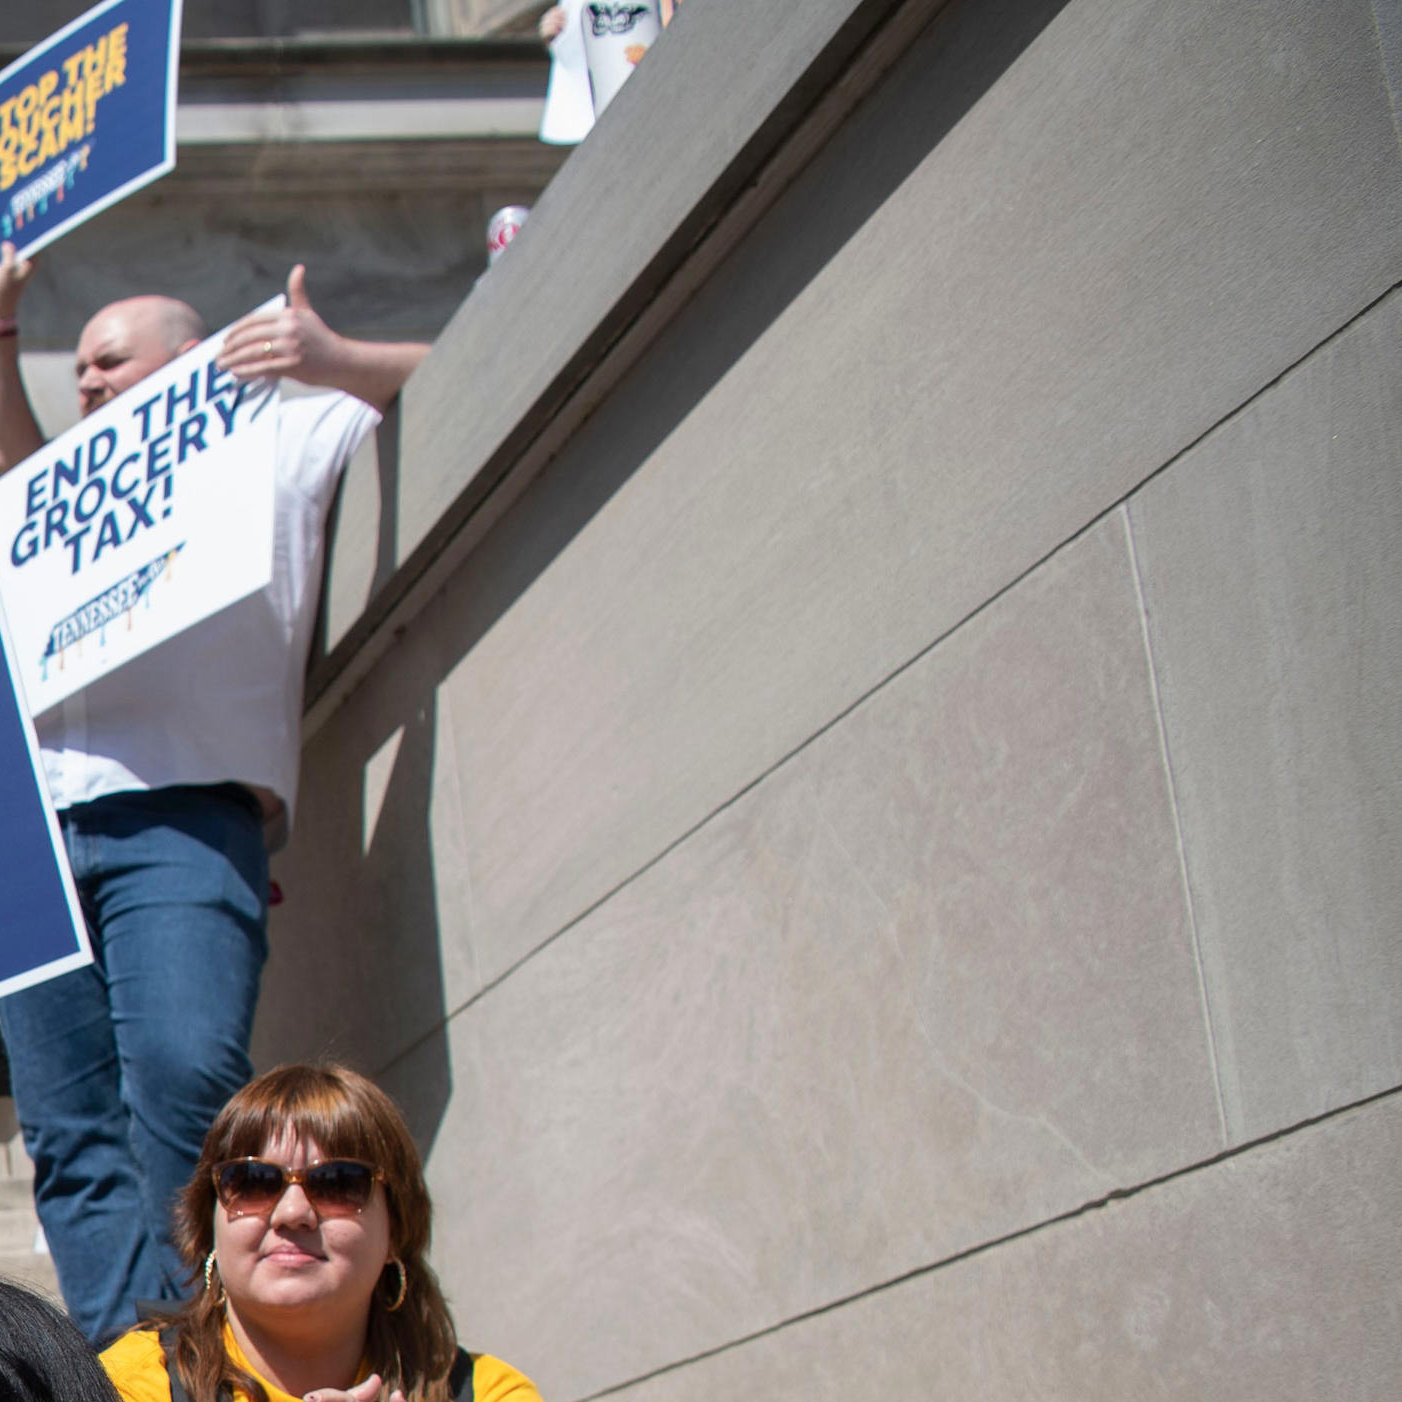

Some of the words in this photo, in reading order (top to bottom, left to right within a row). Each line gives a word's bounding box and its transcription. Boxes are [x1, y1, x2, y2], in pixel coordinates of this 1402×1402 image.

[63, 22, 129, 85] THE
[0, 97, 95, 190] SCAM!
[11, 381, 249, 567] GROCERY
[26, 427, 117, 519] END
[133, 359, 233, 443] THE
[64, 473, 173, 575] TAX!
